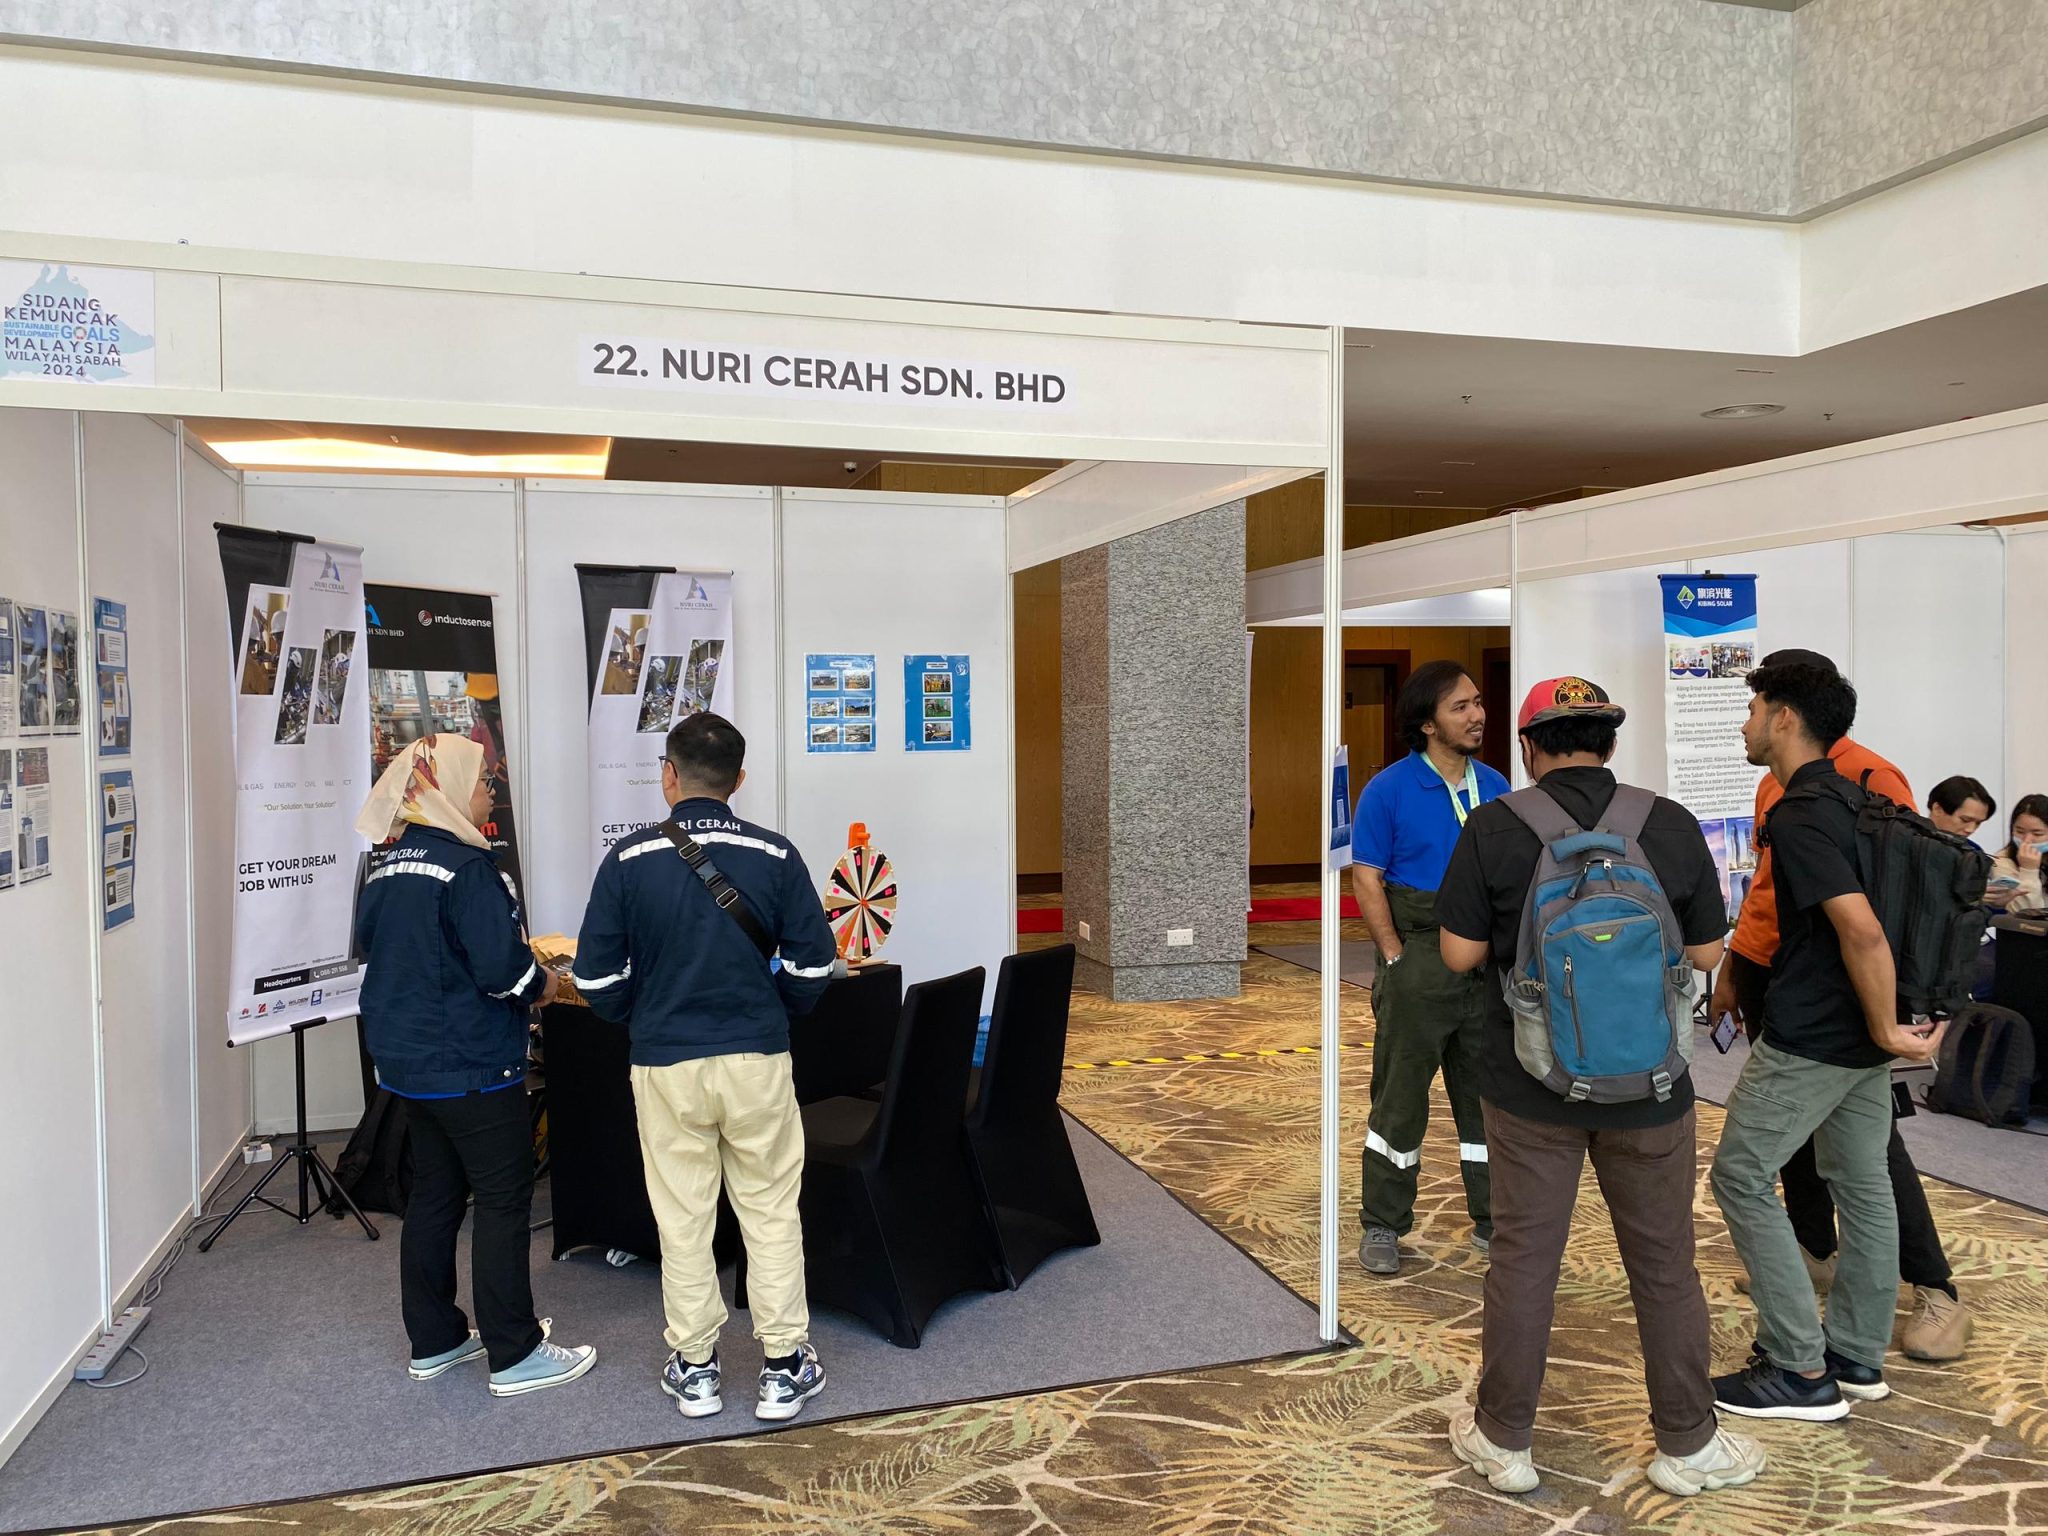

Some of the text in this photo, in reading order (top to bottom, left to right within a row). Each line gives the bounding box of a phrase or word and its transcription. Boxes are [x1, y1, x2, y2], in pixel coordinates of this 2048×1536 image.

[22, 293, 101, 312] SIDANG
[4, 306, 119, 326] KEMUNCAK
[3, 321, 60, 331] SUSTAINABLE
[3, 328, 60, 339] DEVELOPMENT
[60, 325, 120, 342] GOALS
[4, 337, 121, 356] MALAYSIA
[4, 350, 121, 367] WILAYAH SABAH
[43, 363, 85, 377] 2024
[593, 342, 1066, 404] 22. NURI CERAH SDN. BHD
[434, 614, 492, 628] inductosense
[389, 629, 405, 638] BHD
[274, 781, 297, 789] ENERGY
[602, 823, 625, 833] GET
[695, 818, 741, 832] CERAH
[397, 848, 428, 860] CERAH
[238, 854, 337, 875] GET YOUR DREAM
[239, 873, 314, 892] JOB WITH US
[263, 975, 302, 988] Headquarters
